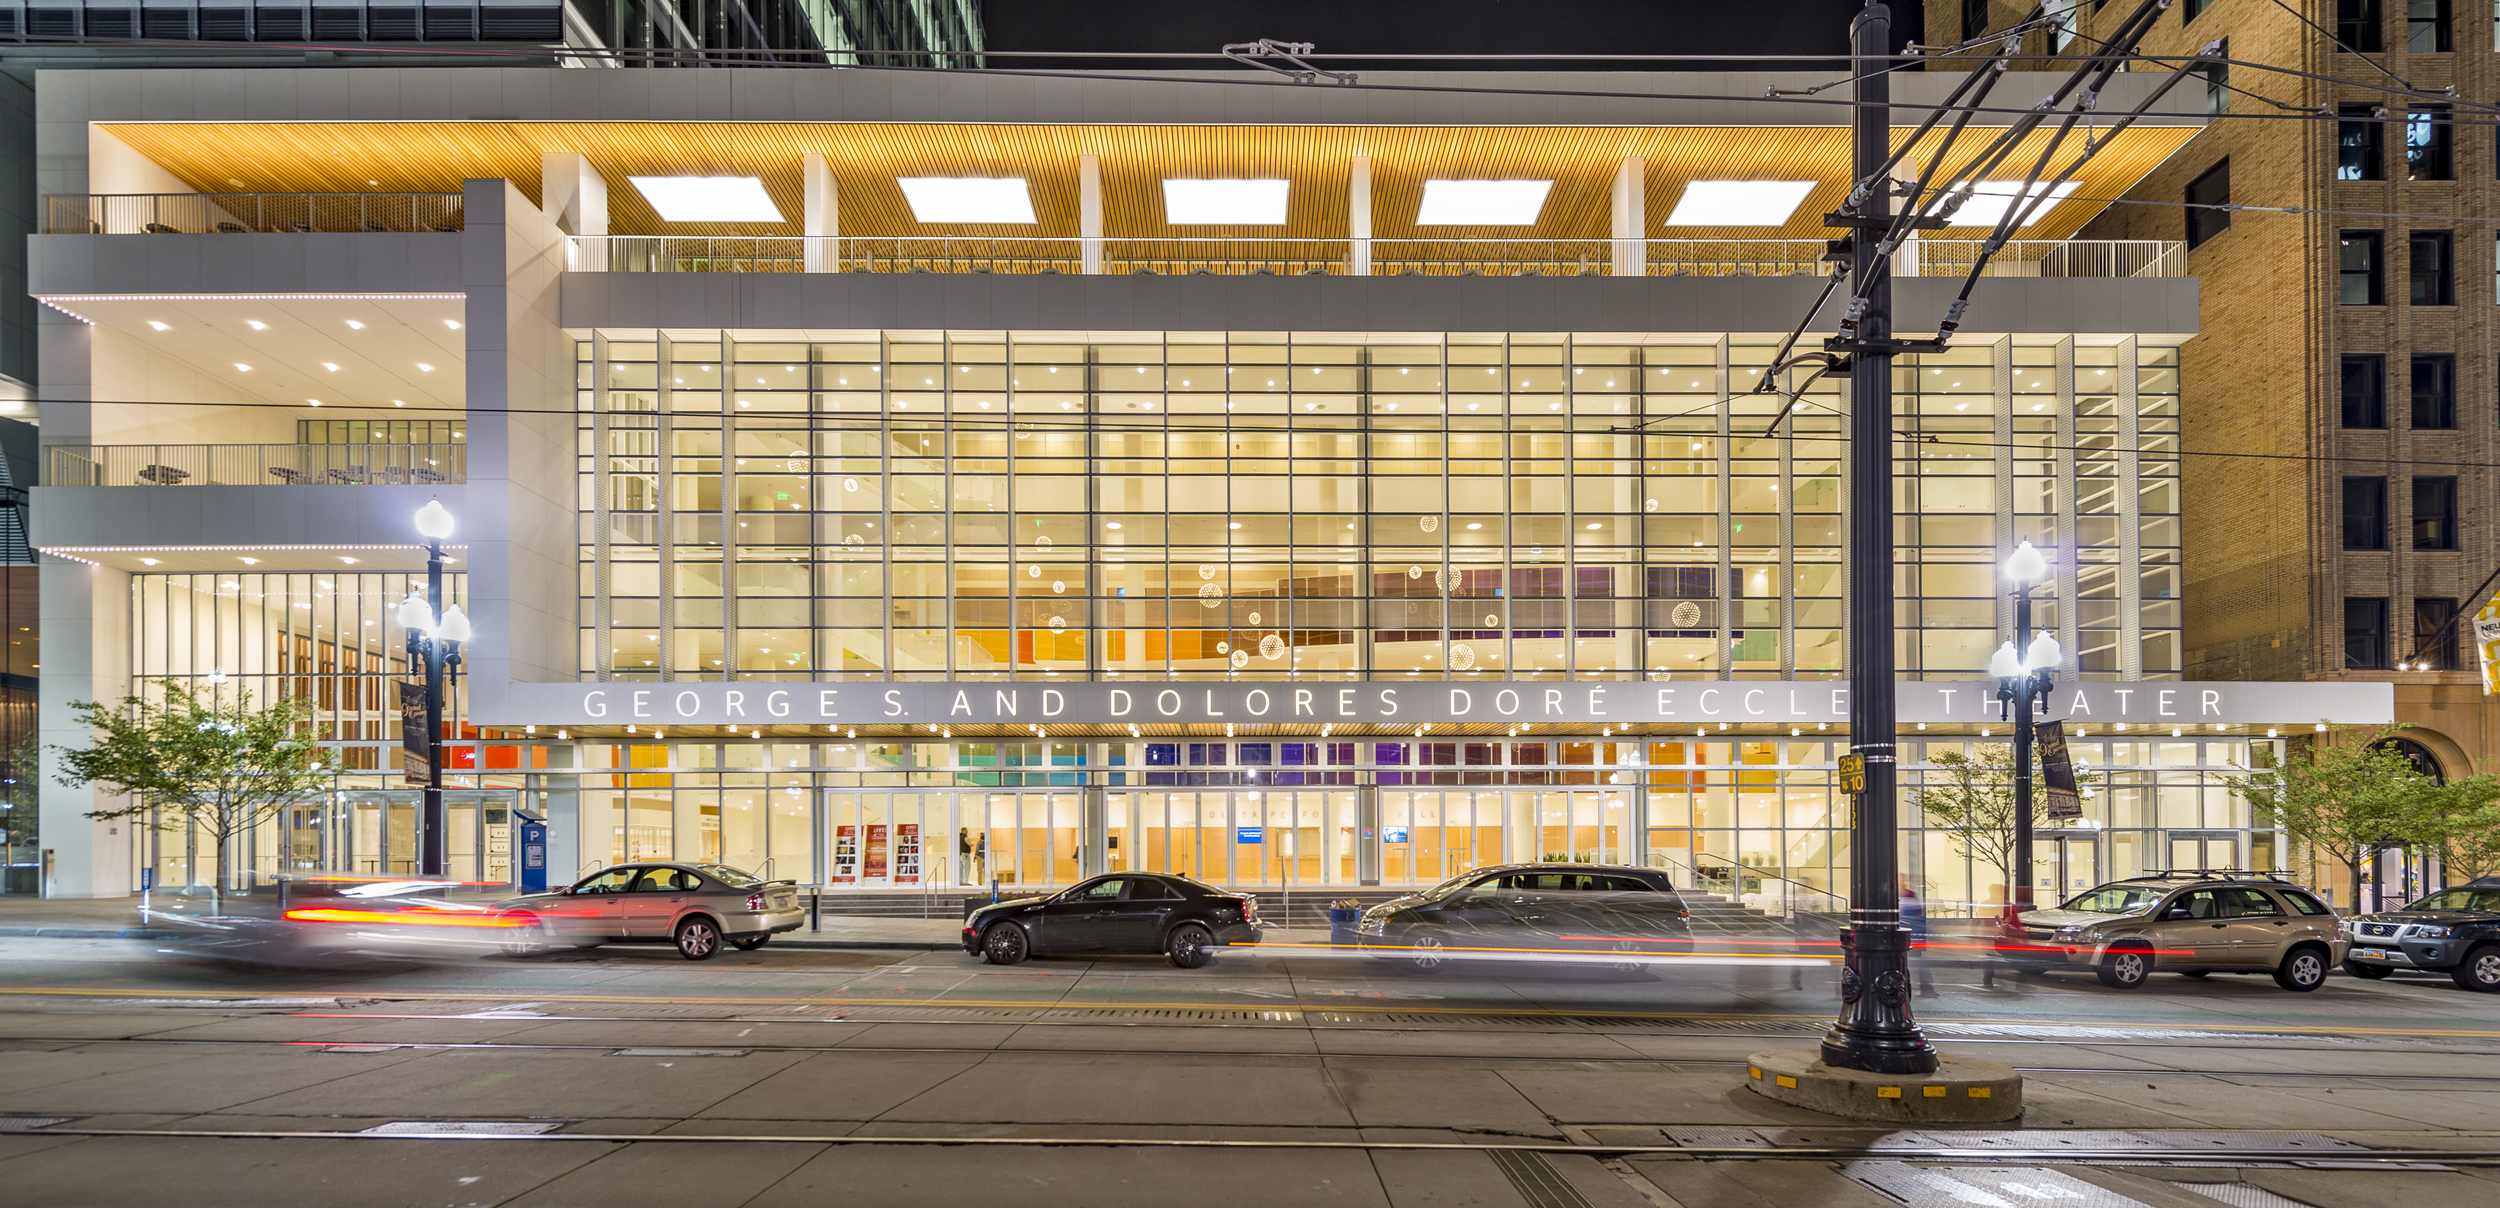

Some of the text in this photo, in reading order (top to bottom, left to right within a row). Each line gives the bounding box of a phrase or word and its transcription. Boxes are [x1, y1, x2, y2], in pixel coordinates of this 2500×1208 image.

[583, 685, 2222, 718] GEORGE S. AND DOLORES DORÉ ECCLE THEATER
[1840, 757, 1855, 773] 25
[1850, 775, 1864, 791] 10
[1209, 811, 1258, 819] DETA
[1397, 810, 1436, 819] HLL
[530, 831, 540, 841] P
